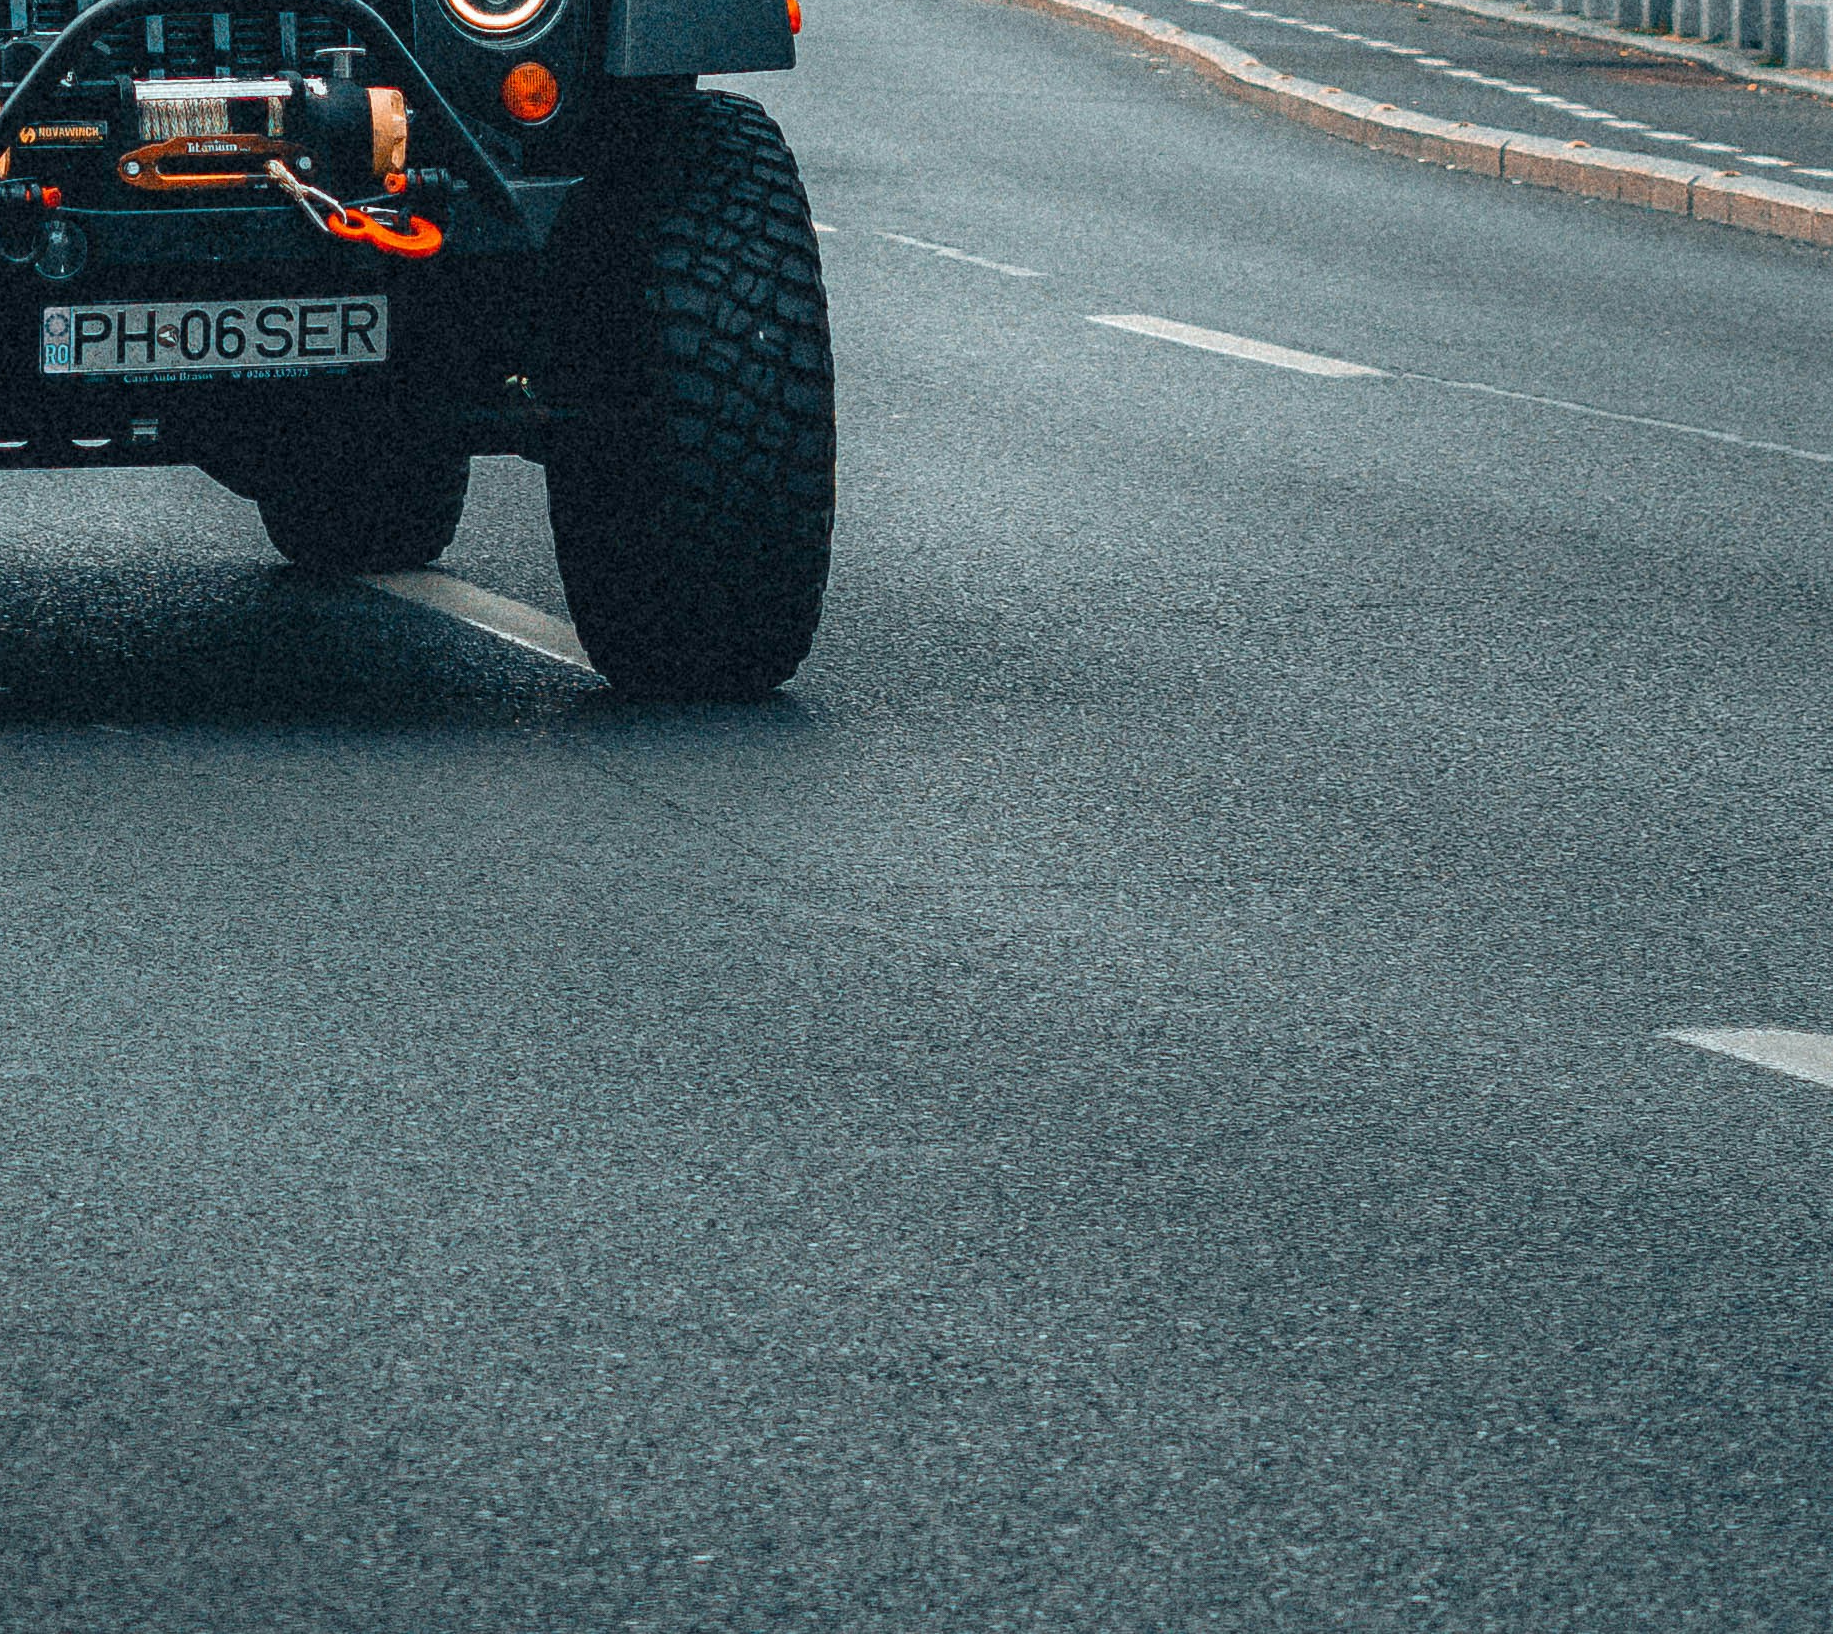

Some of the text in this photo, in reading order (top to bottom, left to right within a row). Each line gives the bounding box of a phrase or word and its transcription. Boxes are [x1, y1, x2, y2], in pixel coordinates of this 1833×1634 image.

[38, 126, 99, 138] NOVAWINCH
[187, 140, 238, 153] Titanium
[45, 344, 68, 365] RO
[123, 374, 148, 384] Casa
[152, 373, 176, 382] Auto
